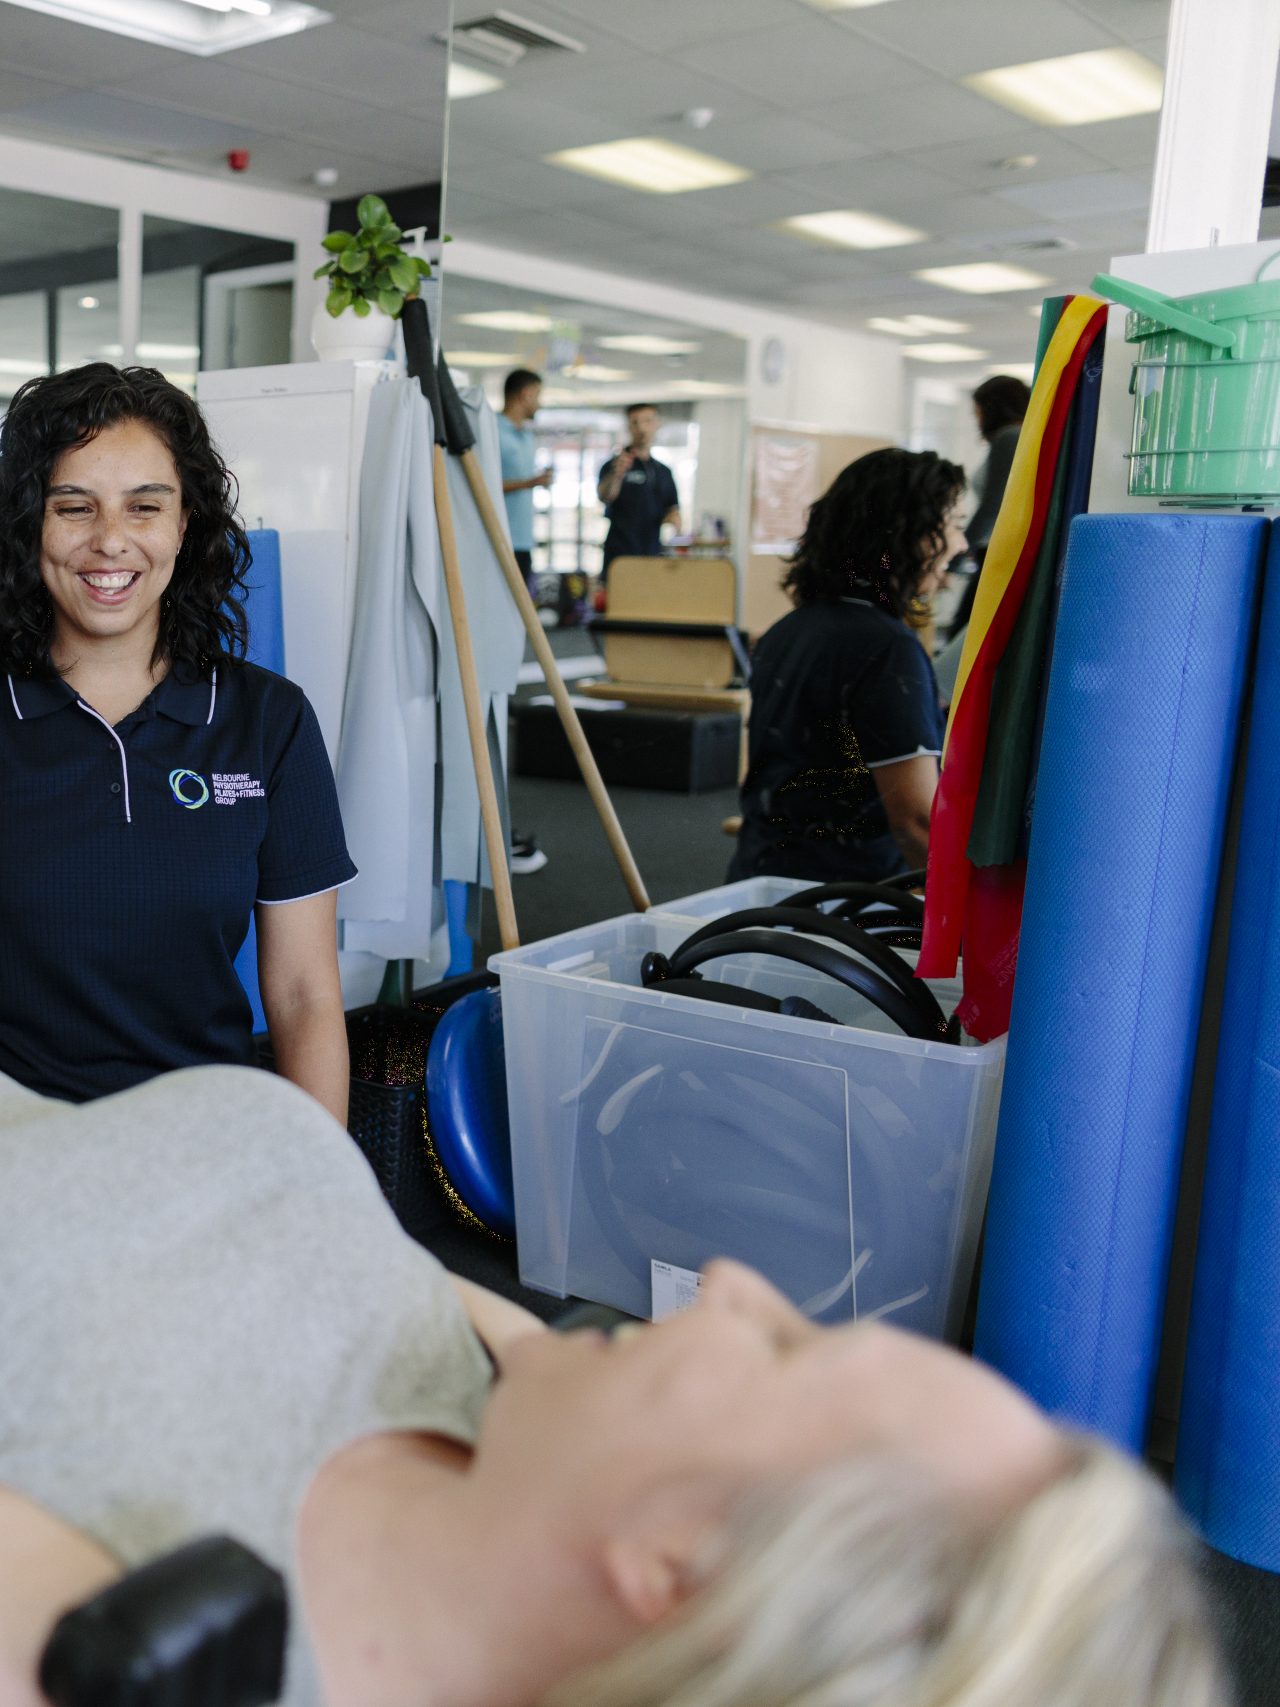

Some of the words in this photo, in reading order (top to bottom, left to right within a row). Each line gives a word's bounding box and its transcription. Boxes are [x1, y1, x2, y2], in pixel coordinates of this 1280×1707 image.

[212, 773, 250, 782] MELBOURNE
[213, 780, 260, 790] PHYSIOTHERAPY
[215, 796, 236, 805] GROUP
